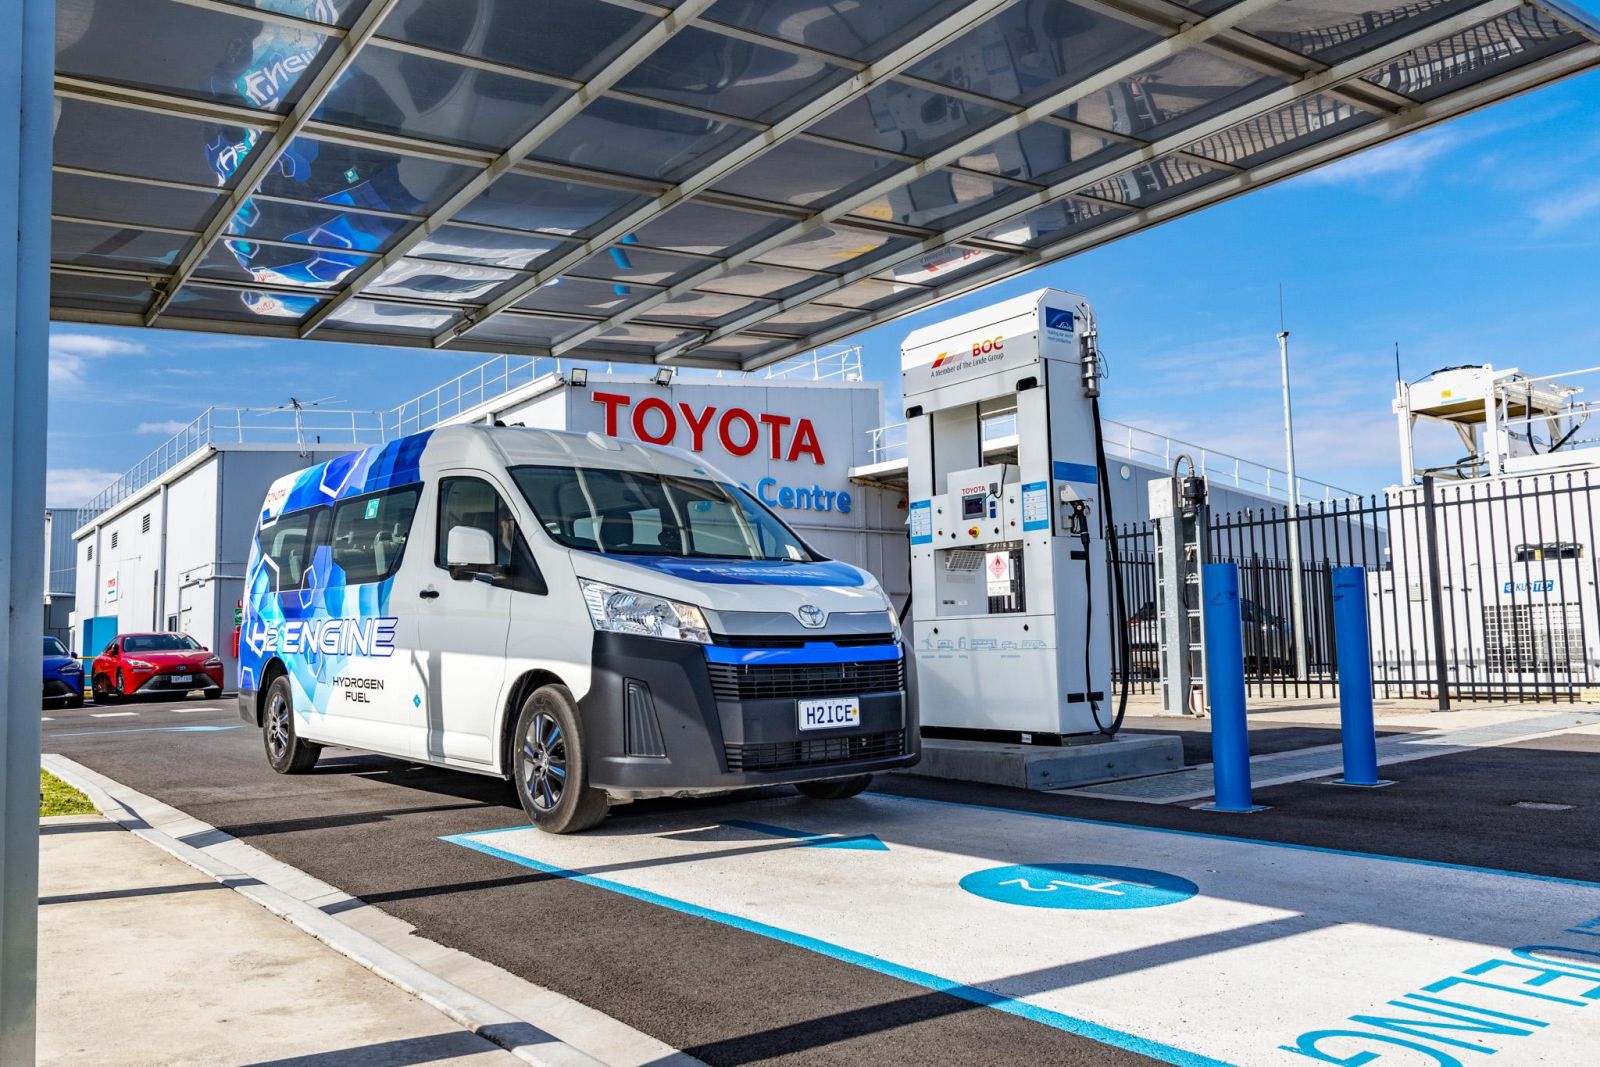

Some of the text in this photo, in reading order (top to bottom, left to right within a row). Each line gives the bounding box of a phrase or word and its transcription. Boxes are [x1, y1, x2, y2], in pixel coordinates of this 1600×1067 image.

[972, 335, 1004, 357] BOC
[935, 364, 956, 377] Member
[956, 363, 962, 371] of
[972, 357, 987, 367] Linde
[987, 352, 1005, 362] Group
[591, 391, 825, 465] TOYOTA
[756, 476, 851, 513] Centre
[962, 485, 986, 495] TOYOTA
[250, 617, 399, 657] H2 ENGINE
[332, 676, 384, 690] HYDROGEN
[345, 691, 371, 703] FUEL
[806, 704, 853, 725] H2ICE
